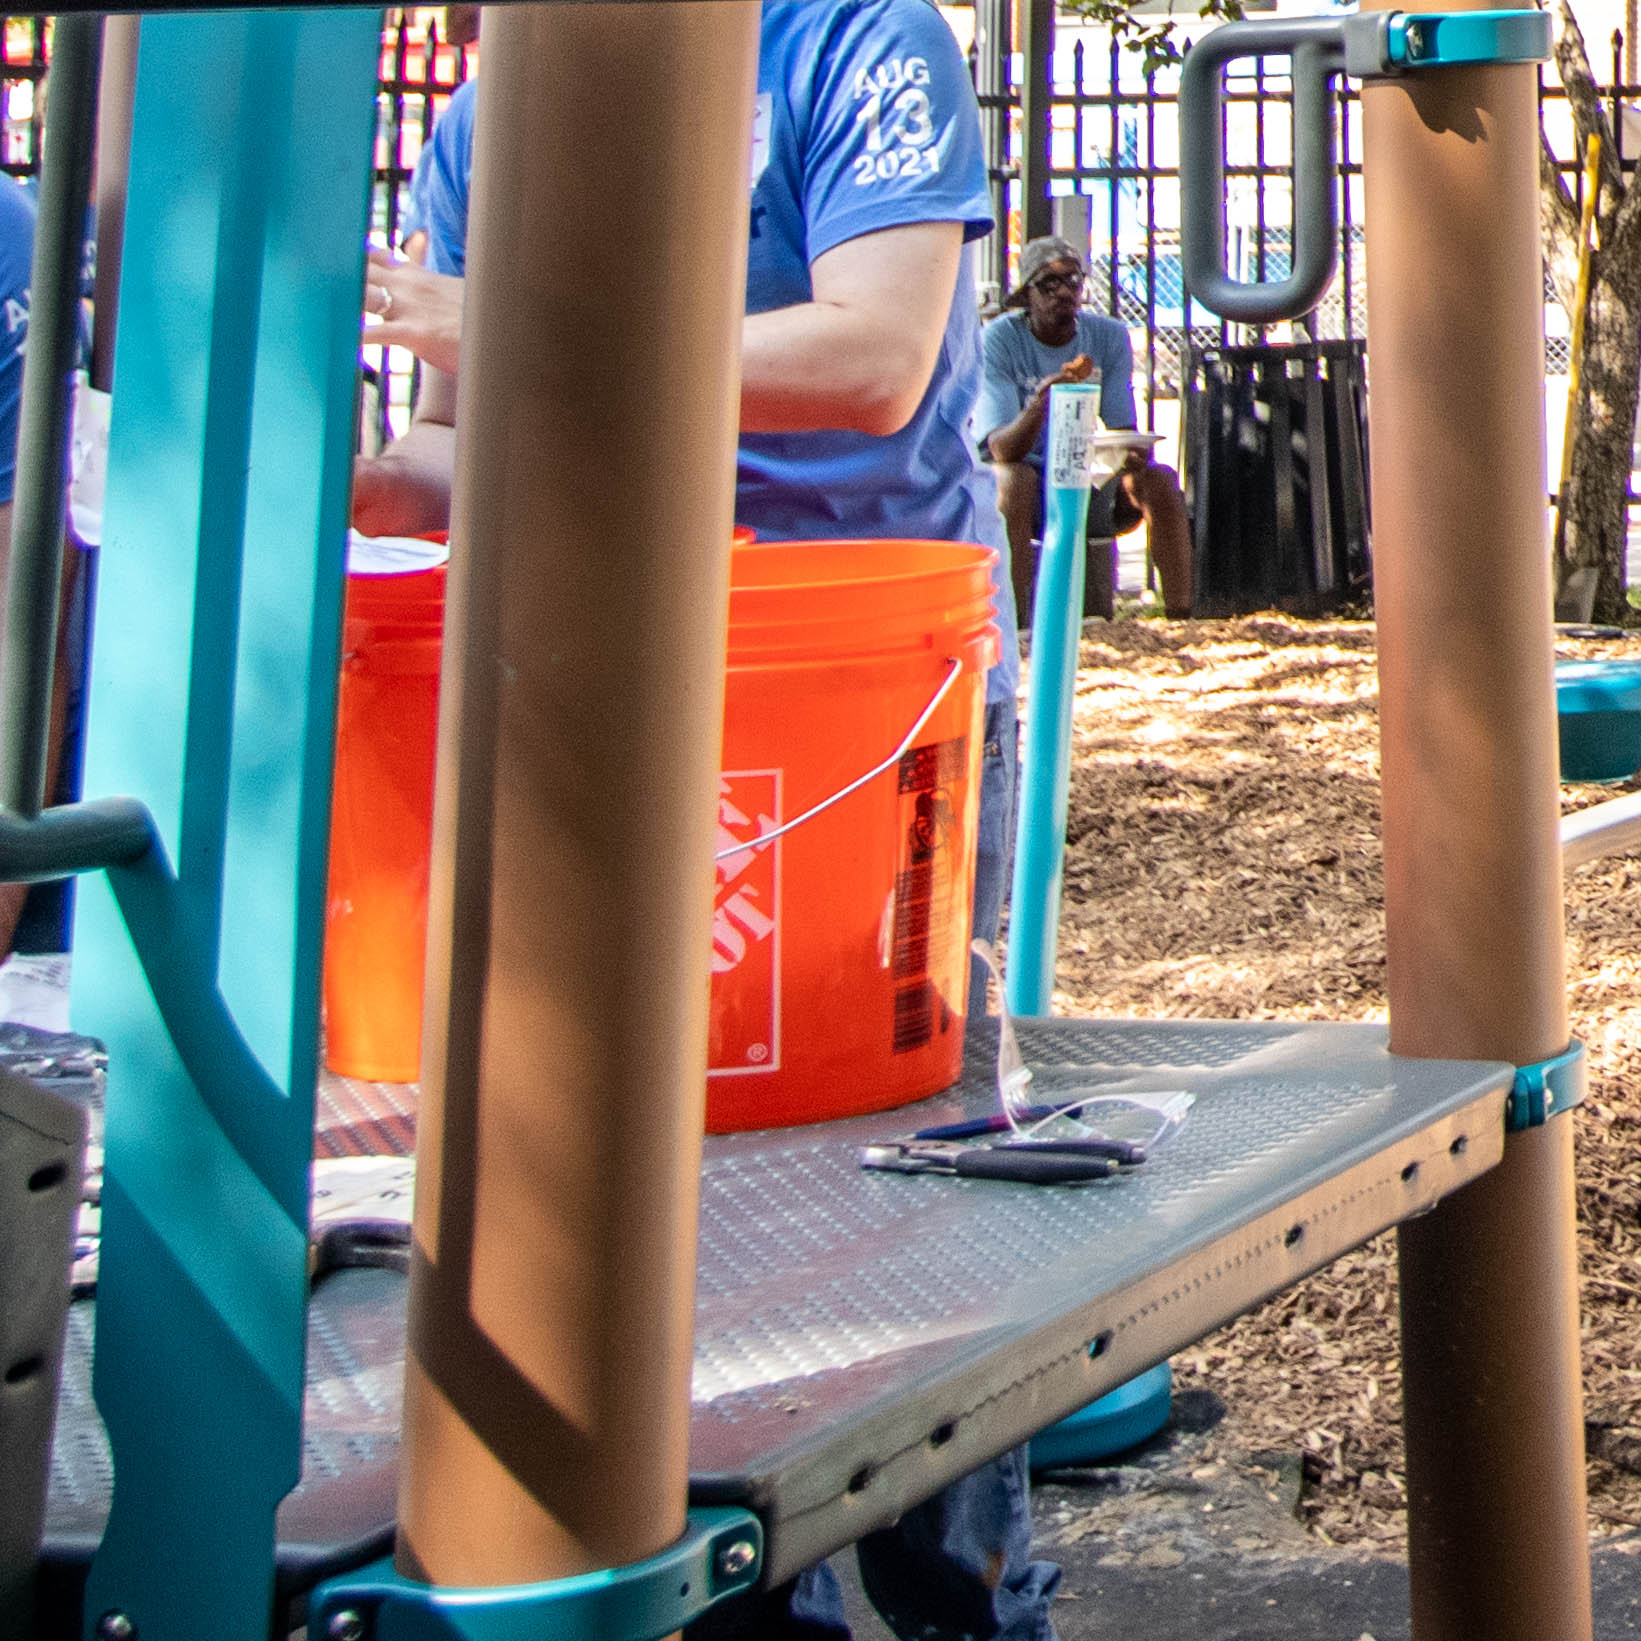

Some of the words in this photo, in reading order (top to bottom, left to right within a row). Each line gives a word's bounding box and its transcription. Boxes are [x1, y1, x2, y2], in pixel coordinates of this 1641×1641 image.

[853, 56, 930, 100] AUG
[856, 88, 933, 151] 13
[854, 146, 940, 186] 2021
